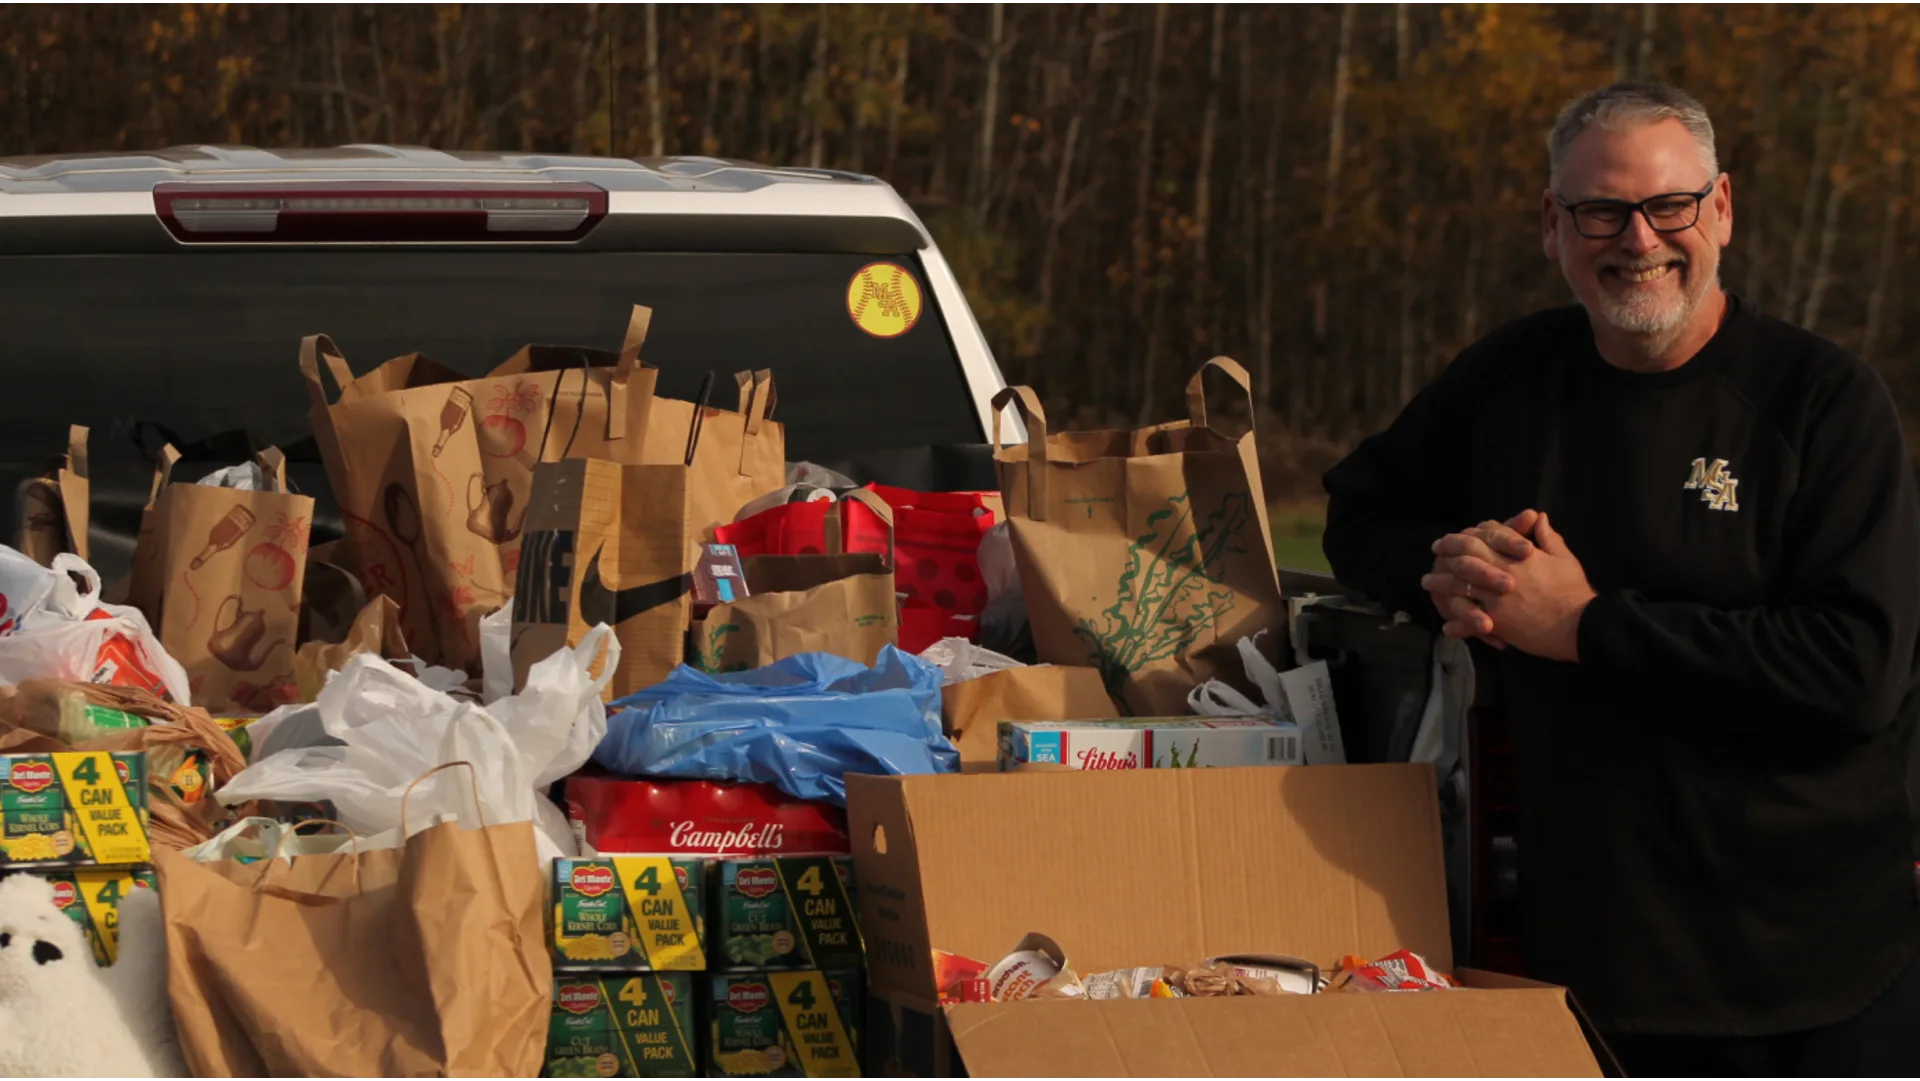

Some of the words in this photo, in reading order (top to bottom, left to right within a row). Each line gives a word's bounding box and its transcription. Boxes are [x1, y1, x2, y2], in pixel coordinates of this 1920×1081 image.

[1036, 754, 1056, 762] SEA
[72, 757, 101, 785] 4
[80, 788, 113, 806] CAN
[89, 809, 122, 820] VALUE
[97, 823, 128, 836] PACK
[669, 820, 784, 854] Campbell's
[634, 866, 662, 895] 4
[797, 866, 824, 896] 4
[97, 879, 124, 909] 4
[642, 899, 673, 916] CAN
[804, 899, 836, 916] CAN
[648, 919, 680, 930] VALUE
[812, 918, 842, 930] VALUE
[656, 933, 685, 946] PACK
[819, 931, 848, 945] PACK
[619, 977, 647, 1006] 4
[788, 980, 816, 1010] 4
[627, 1009, 659, 1026] CAN
[796, 1012, 828, 1030] CAN
[636, 1031, 668, 1043] VALUE
[643, 1046, 673, 1059] PACK
[812, 1046, 840, 1059] PACK
